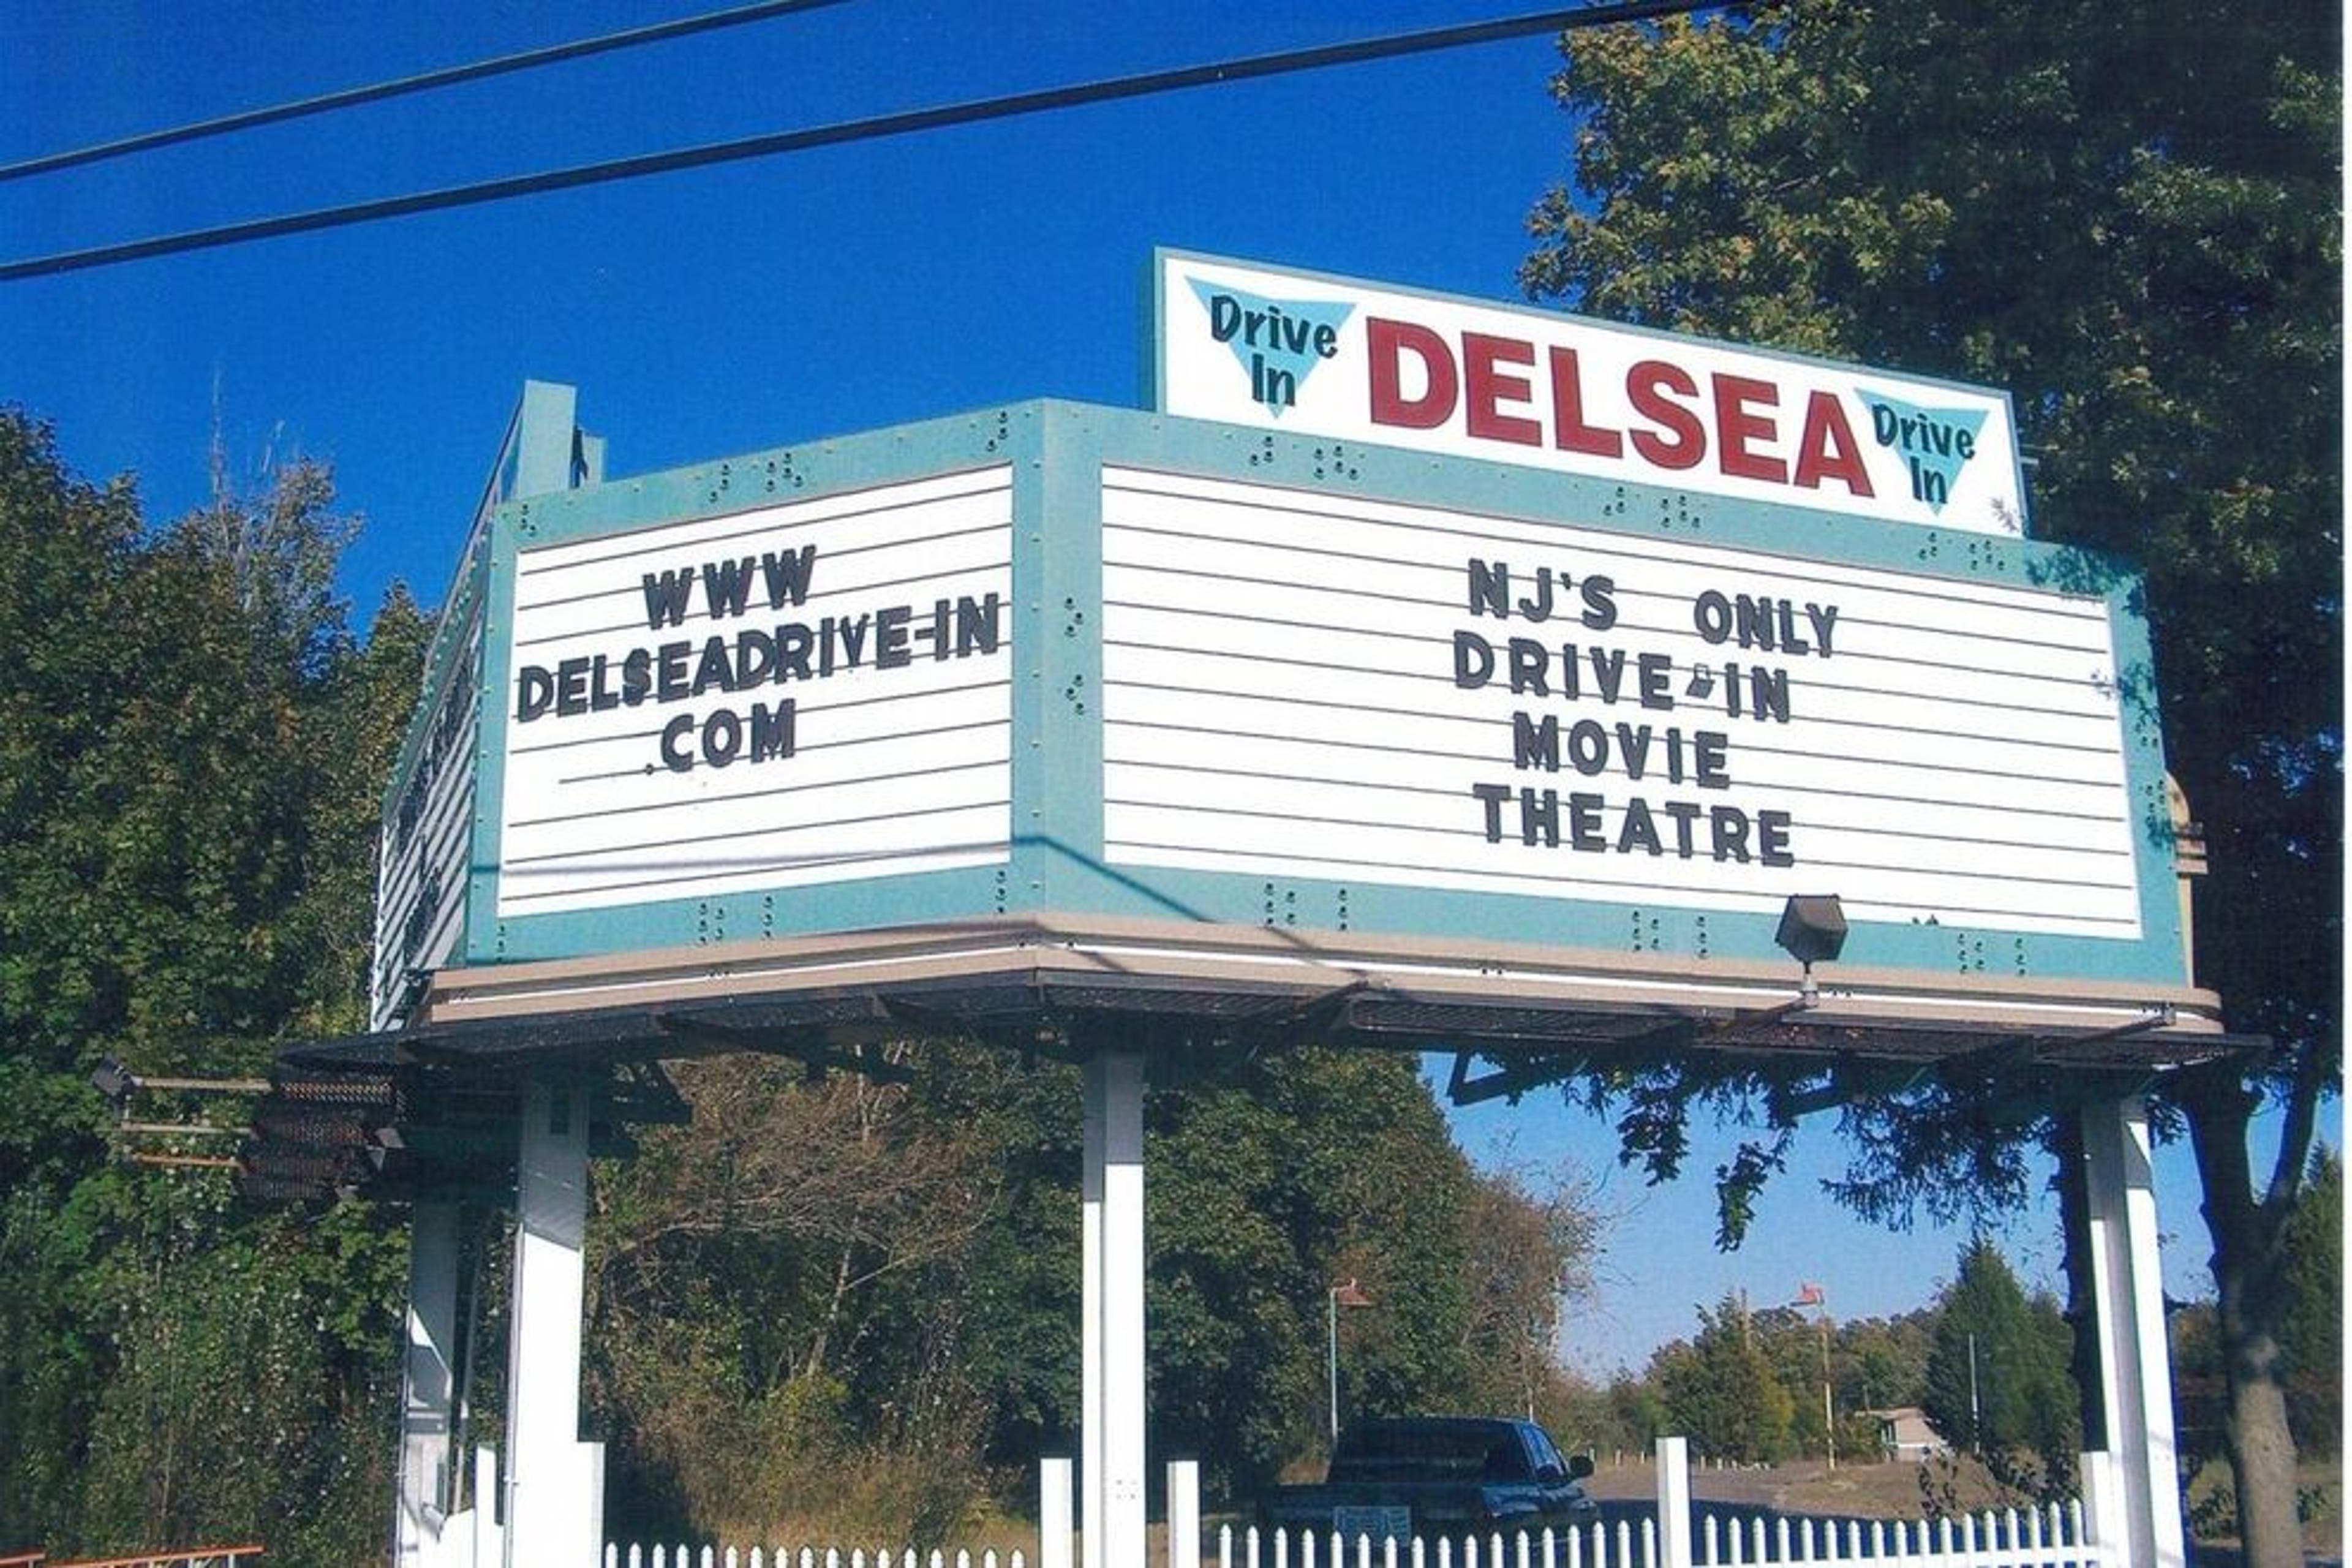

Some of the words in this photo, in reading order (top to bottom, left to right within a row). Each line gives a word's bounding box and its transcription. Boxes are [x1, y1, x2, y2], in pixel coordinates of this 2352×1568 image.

[1210, 294, 1338, 360] Drive
[1251, 358, 1296, 407] In
[1366, 316, 1875, 499] DELSEA
[1872, 403, 1975, 462] Drive
[1910, 457, 1949, 505] In
[643, 545, 817, 631] WWW
[1469, 558, 1618, 631] NJ'S
[1694, 589, 1838, 658] ONLY
[518, 592, 1000, 723] DELSEADRIVE-IN
[645, 698, 796, 775] .COM
[1513, 711, 1730, 790] MOVIE
[1472, 783, 1795, 867] THEATRE
